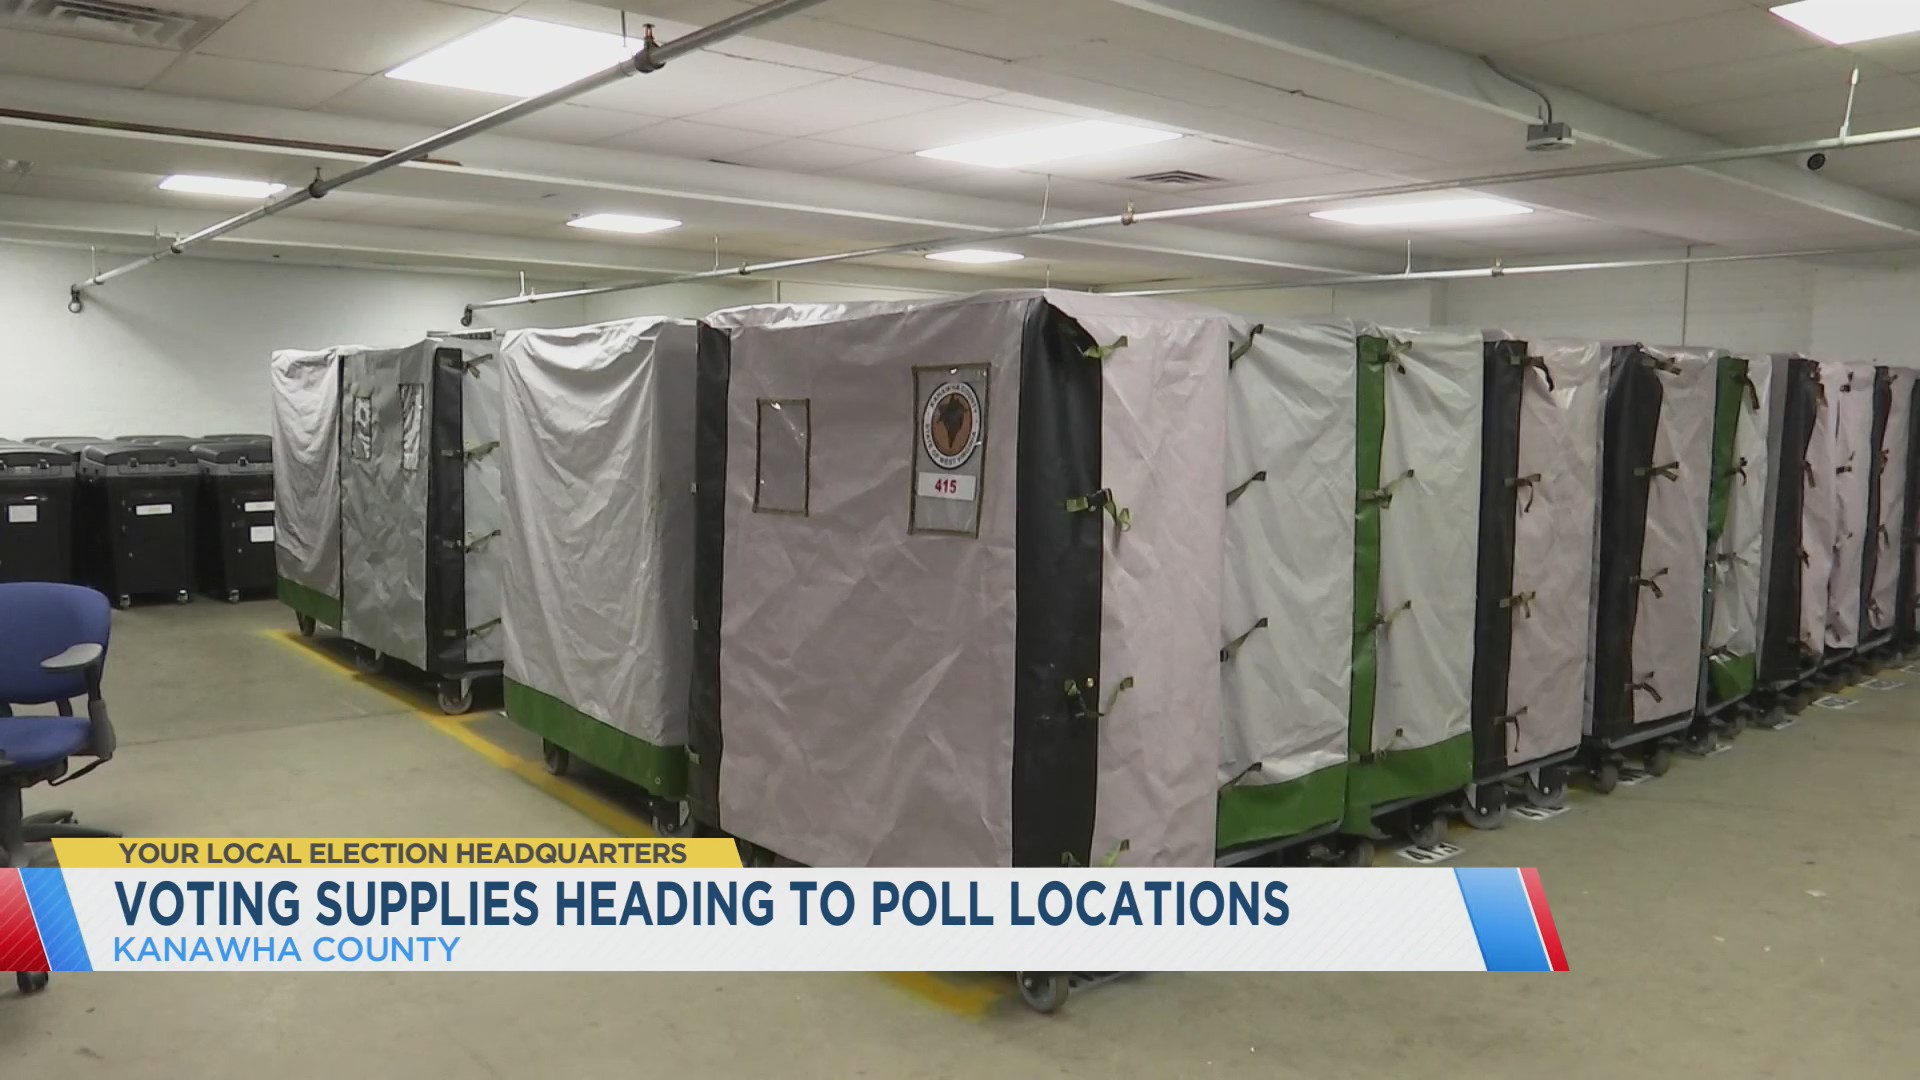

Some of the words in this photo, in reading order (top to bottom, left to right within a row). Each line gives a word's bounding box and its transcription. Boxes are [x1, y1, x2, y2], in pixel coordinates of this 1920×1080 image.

[960, 384, 977, 413] COUNTY
[924, 423, 933, 450] STATE
[939, 456, 956, 466] WEST
[935, 479, 957, 494] 415
